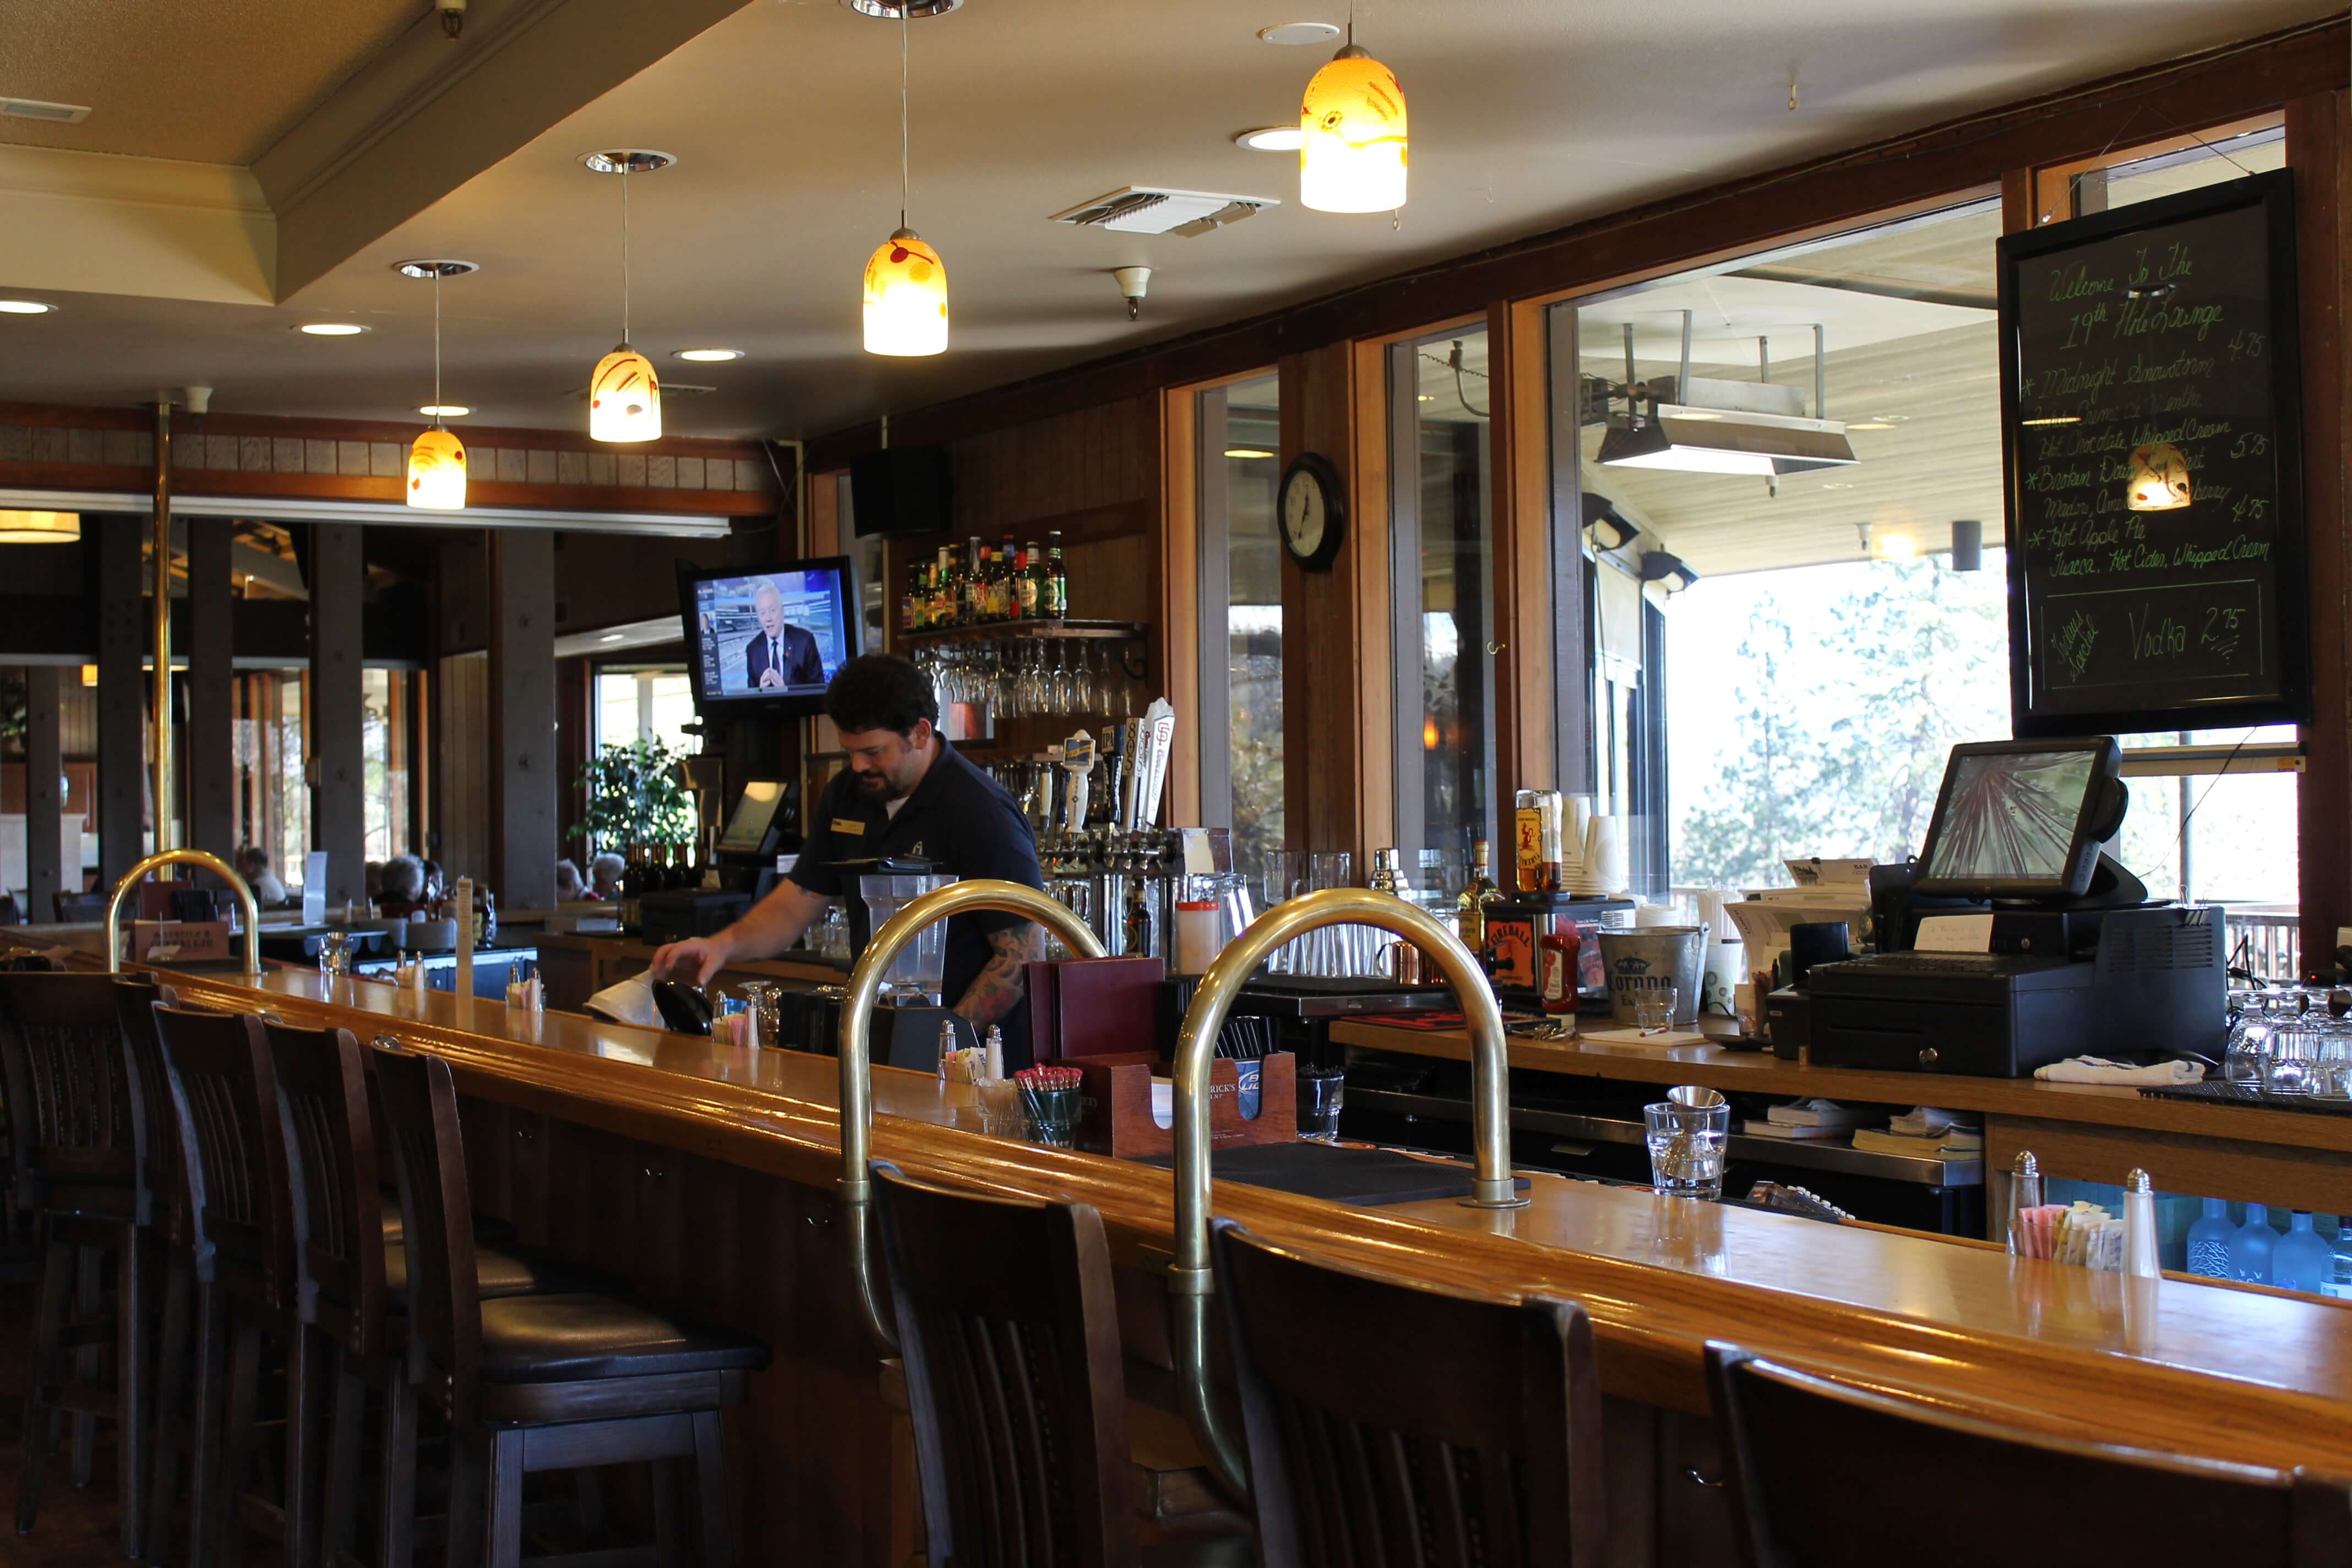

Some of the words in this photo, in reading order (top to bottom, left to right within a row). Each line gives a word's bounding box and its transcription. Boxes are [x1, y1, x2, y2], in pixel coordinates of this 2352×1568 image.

[2050, 260, 2114, 302] Welcome
[2128, 247, 2148, 285] To
[2159, 242, 2193, 280] The
[2060, 302, 2108, 350] 19th
[2151, 290, 2224, 342] Lounge
[2039, 357, 2118, 404] Midnight
[2122, 349, 2215, 385] Snowstorm
[2131, 417, 2186, 450] Whipped
[2037, 465, 2091, 492] Broken
[2046, 522, 2078, 551] Hot
[2079, 519, 2119, 552] Apple
[2125, 514, 2146, 540] Pie
[2109, 548, 2132, 573] Hot
[2173, 541, 2231, 568] Whipped
[2232, 533, 2270, 561] Cream
[2128, 603, 2186, 661] Vodka
[1102, 731, 1114, 749] IPA
[1125, 722, 1136, 771] 805
[1490, 924, 1531, 948] FIREBALL
[1607, 969, 1670, 993] Corona
[1210, 1084, 1235, 1093] RICK'S
